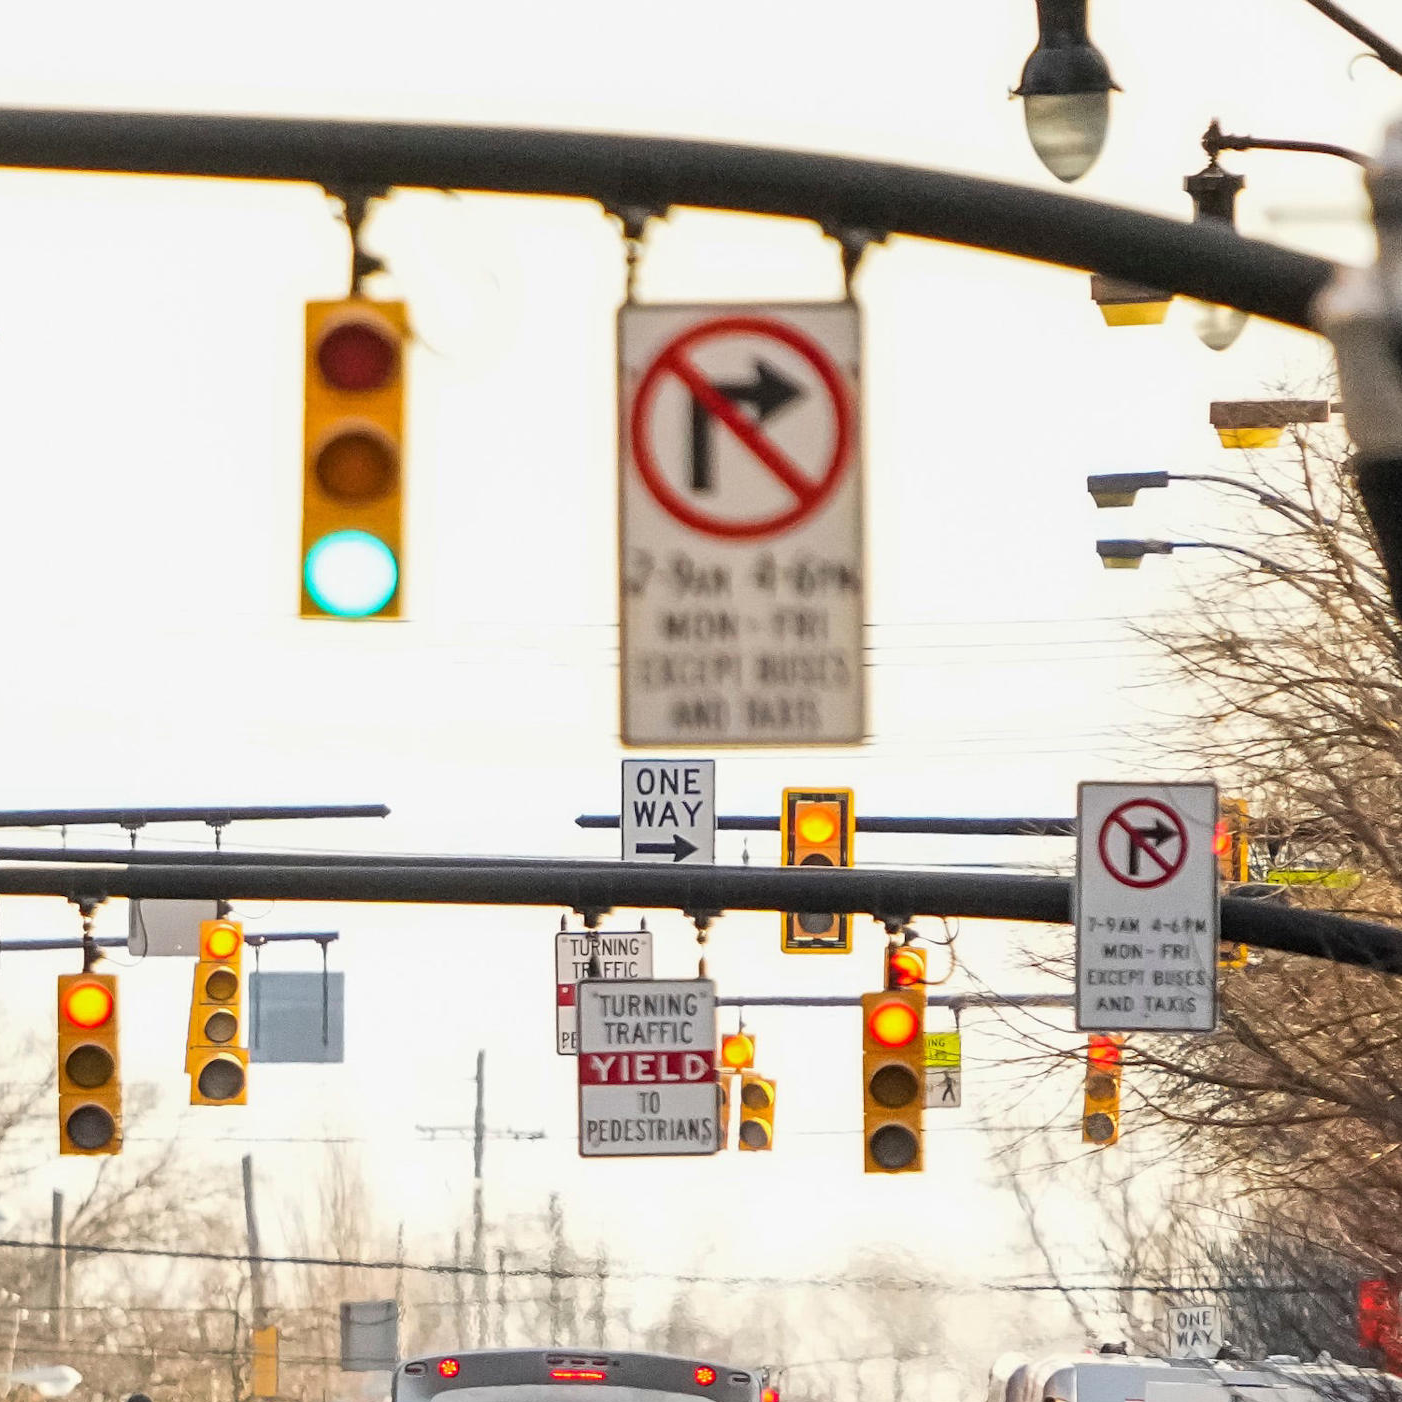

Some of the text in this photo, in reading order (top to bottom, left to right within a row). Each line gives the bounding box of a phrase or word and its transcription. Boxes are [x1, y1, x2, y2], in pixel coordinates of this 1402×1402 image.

[636, 767, 701, 795] ONE
[633, 800, 703, 827] WAY
[570, 938, 639, 956] TURNING
[572, 961, 638, 978] TRFFIC
[1087, 969, 1145, 986] EXCEPT
[599, 993, 698, 1017] TURNING
[1097, 996, 1197, 1012] AND TAXIS
[604, 1022, 693, 1044] TRAFFIC
[591, 1054, 708, 1081] YIELD
[639, 1091, 661, 1114] TO
[586, 1117, 712, 1142] PEDESTRIANS
[1177, 1310, 1212, 1330] ONE
[1177, 1329, 1213, 1347] WAY
